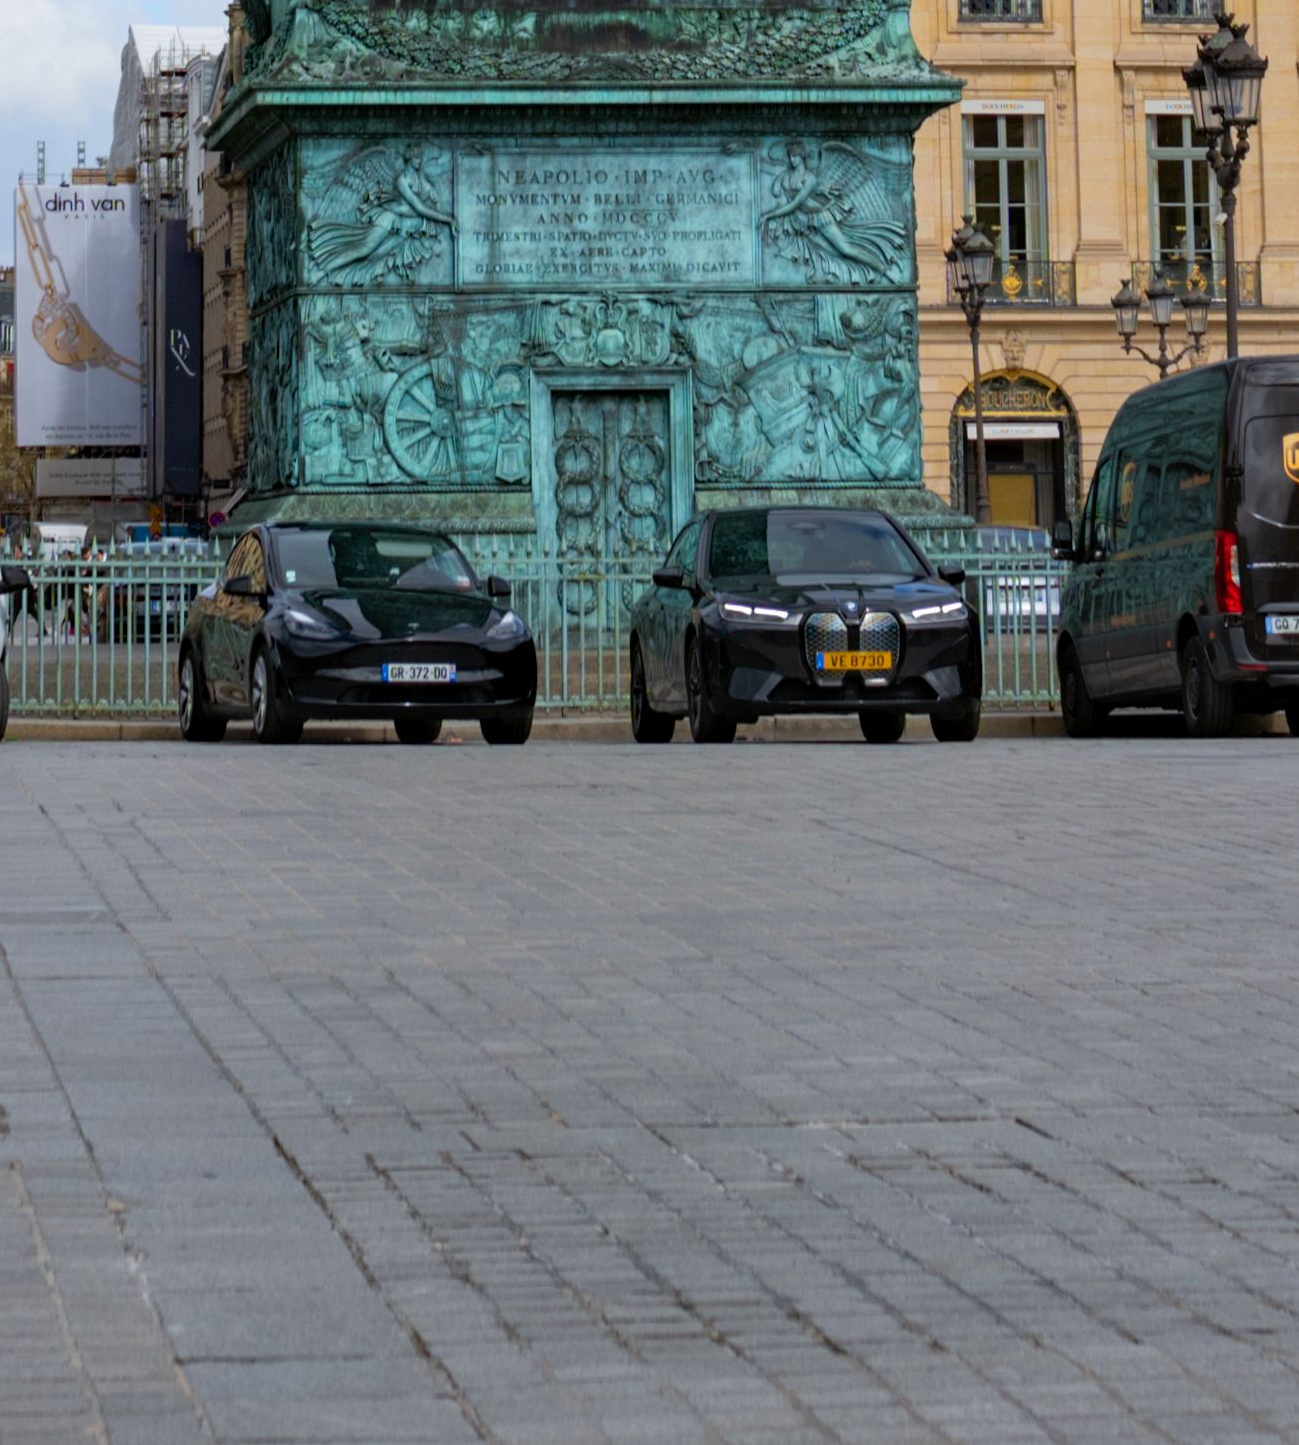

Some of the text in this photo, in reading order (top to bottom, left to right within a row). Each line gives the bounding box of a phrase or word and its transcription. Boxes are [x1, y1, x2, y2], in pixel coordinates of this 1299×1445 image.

[497, 169, 716, 186] NEAPOLIO IMP AVG
[45, 192, 125, 212] dinh van
[475, 193, 738, 206] MONVMENTVM BELLI GERMANICI
[537, 211, 679, 225] ANNO MDCCCV
[473, 231, 542, 243] TRIMESTRI
[548, 231, 592, 243] SPATIO
[672, 231, 742, 243] PROFLIGATI
[550, 247, 667, 258] EX AERE CAPTO
[475, 263, 533, 274] GLORIAE
[685, 262, 741, 273] DICAVIT
[830, 655, 848, 668] VE
